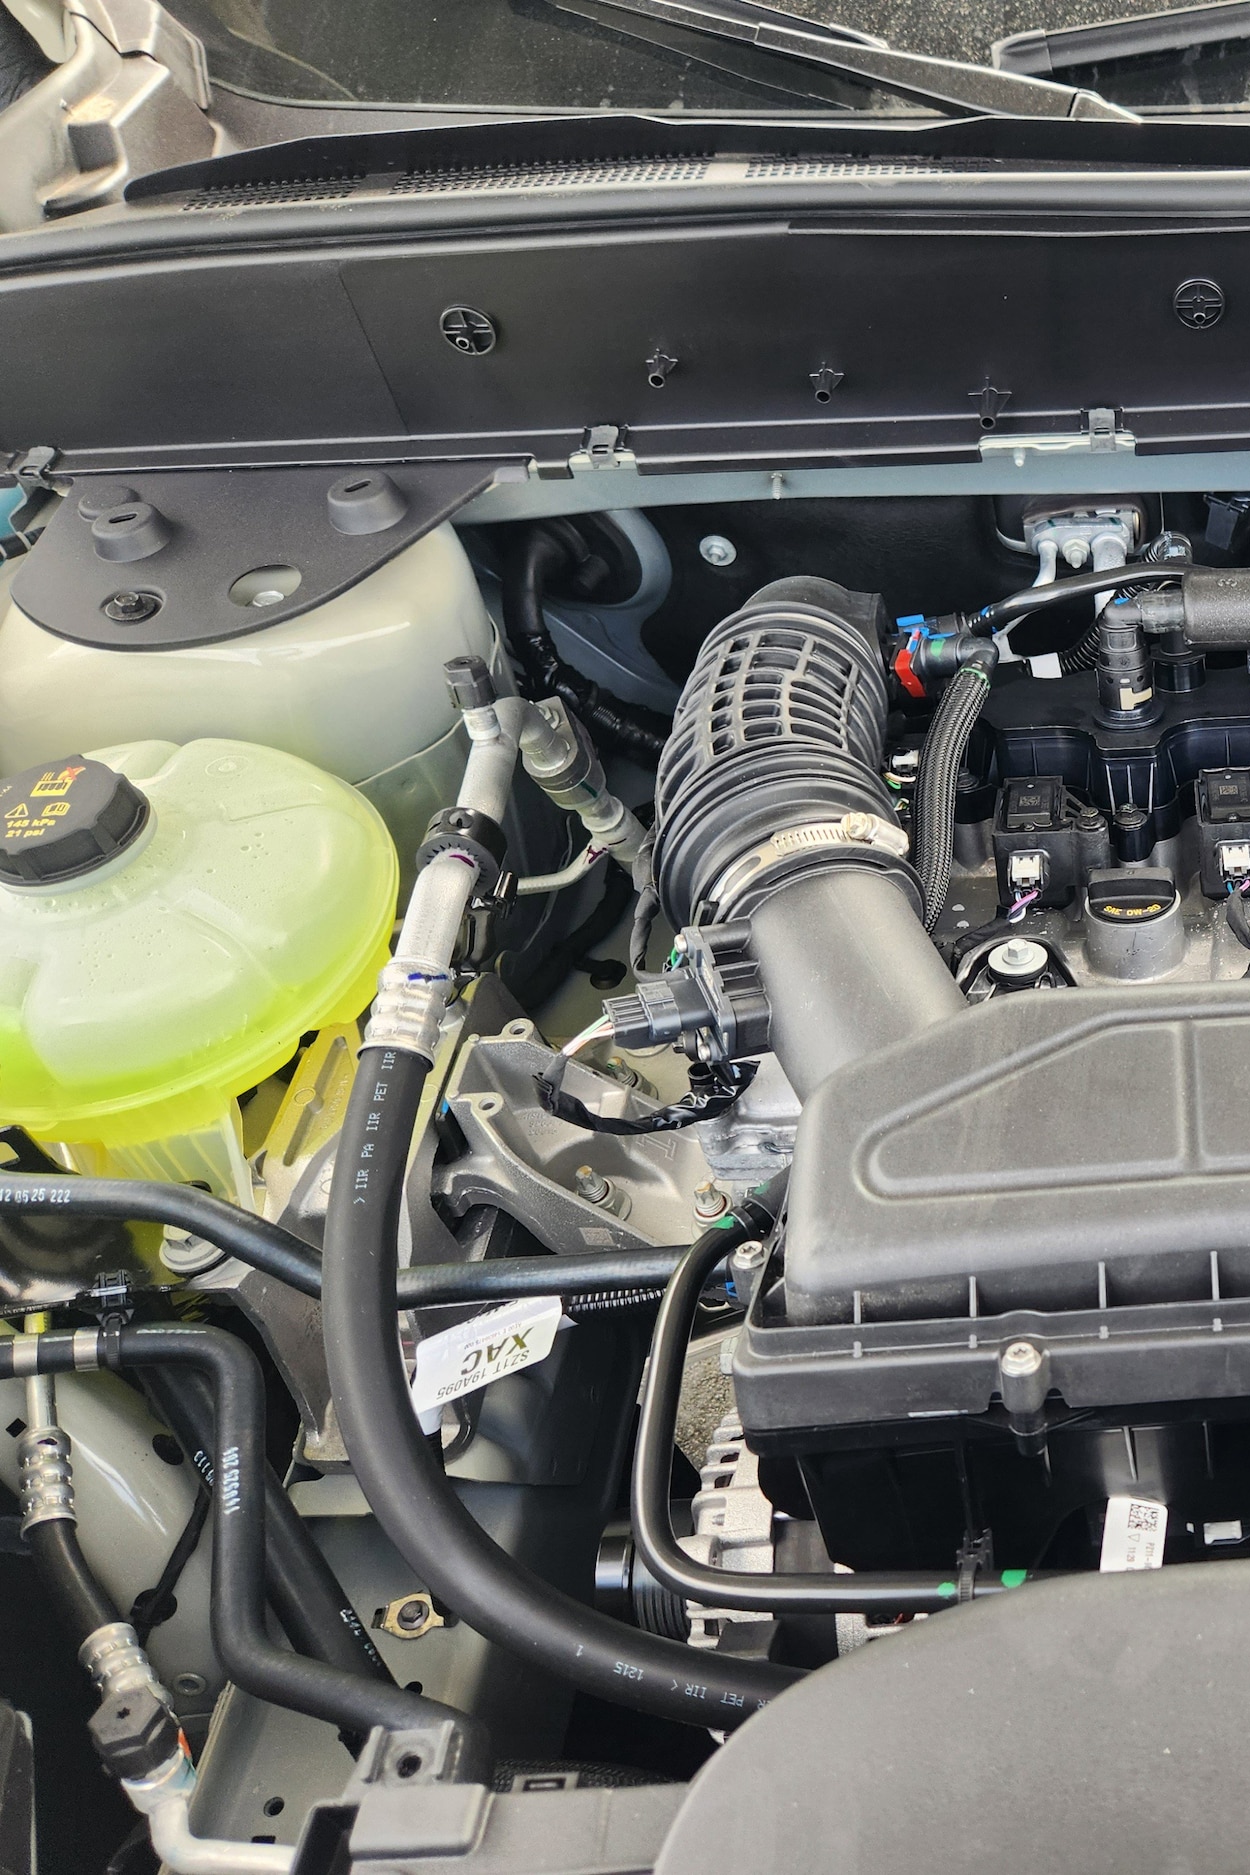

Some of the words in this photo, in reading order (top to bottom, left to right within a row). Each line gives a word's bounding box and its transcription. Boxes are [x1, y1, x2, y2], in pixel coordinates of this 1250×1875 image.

[6, 819, 30, 828] 145
[32, 818, 56, 826] kPa
[5, 829, 22, 838] 21
[23, 828, 45, 838] psi
[1104, 905, 1122, 915] SAE
[1126, 904, 1161, 916] 0W-20
[382, 1051, 396, 1070] IIR
[374, 1082, 388, 1101] PET
[366, 1112, 381, 1131] IIR
[361, 1144, 374, 1158] PA
[355, 1168, 369, 1189] IIR
[461, 1326, 534, 1375] XAC
[492, 1350, 530, 1374] SZ1T
[436, 1370, 486, 1400] 19A095
[613, 1661, 644, 1681] 1215
[685, 1683, 707, 1699] IIR
[720, 1692, 744, 1707] PET
